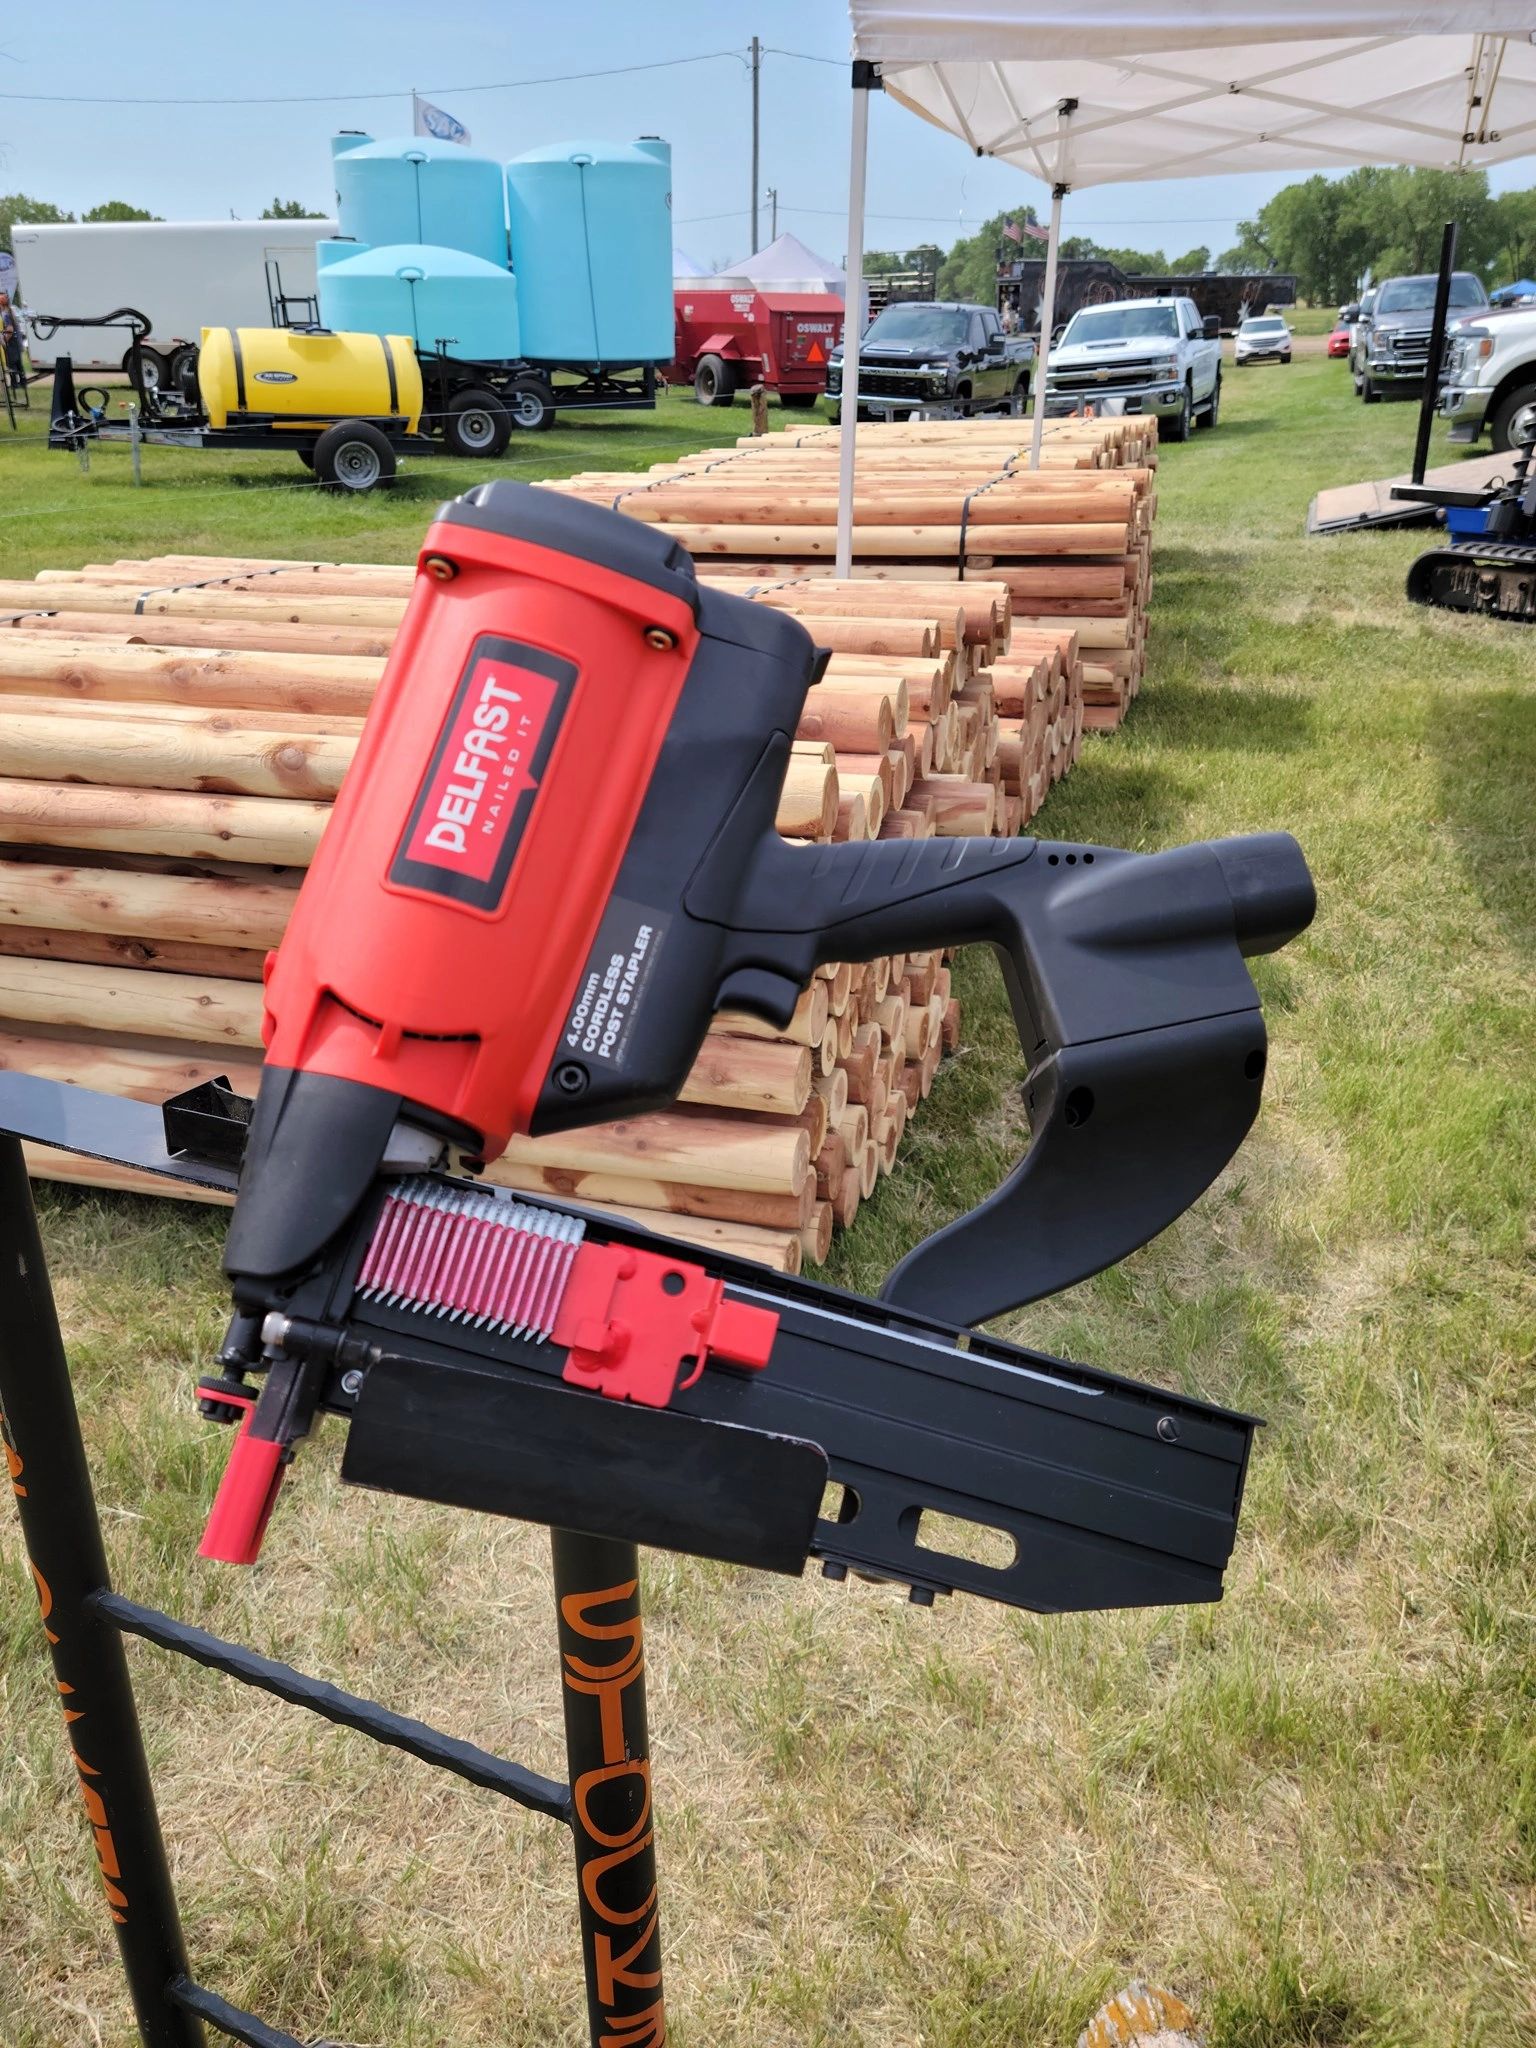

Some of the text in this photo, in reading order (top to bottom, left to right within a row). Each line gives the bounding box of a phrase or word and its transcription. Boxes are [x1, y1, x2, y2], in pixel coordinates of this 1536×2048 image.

[797, 323, 834, 334] OSWALT
[424, 676, 522, 853] DELFAST
[481, 715, 532, 834] NAILED IT
[566, 972, 600, 1047] 4.00mm
[582, 953, 625, 1053] CORDLESS
[598, 1006, 624, 1058] POST
[616, 924, 653, 1006] STAPLER
